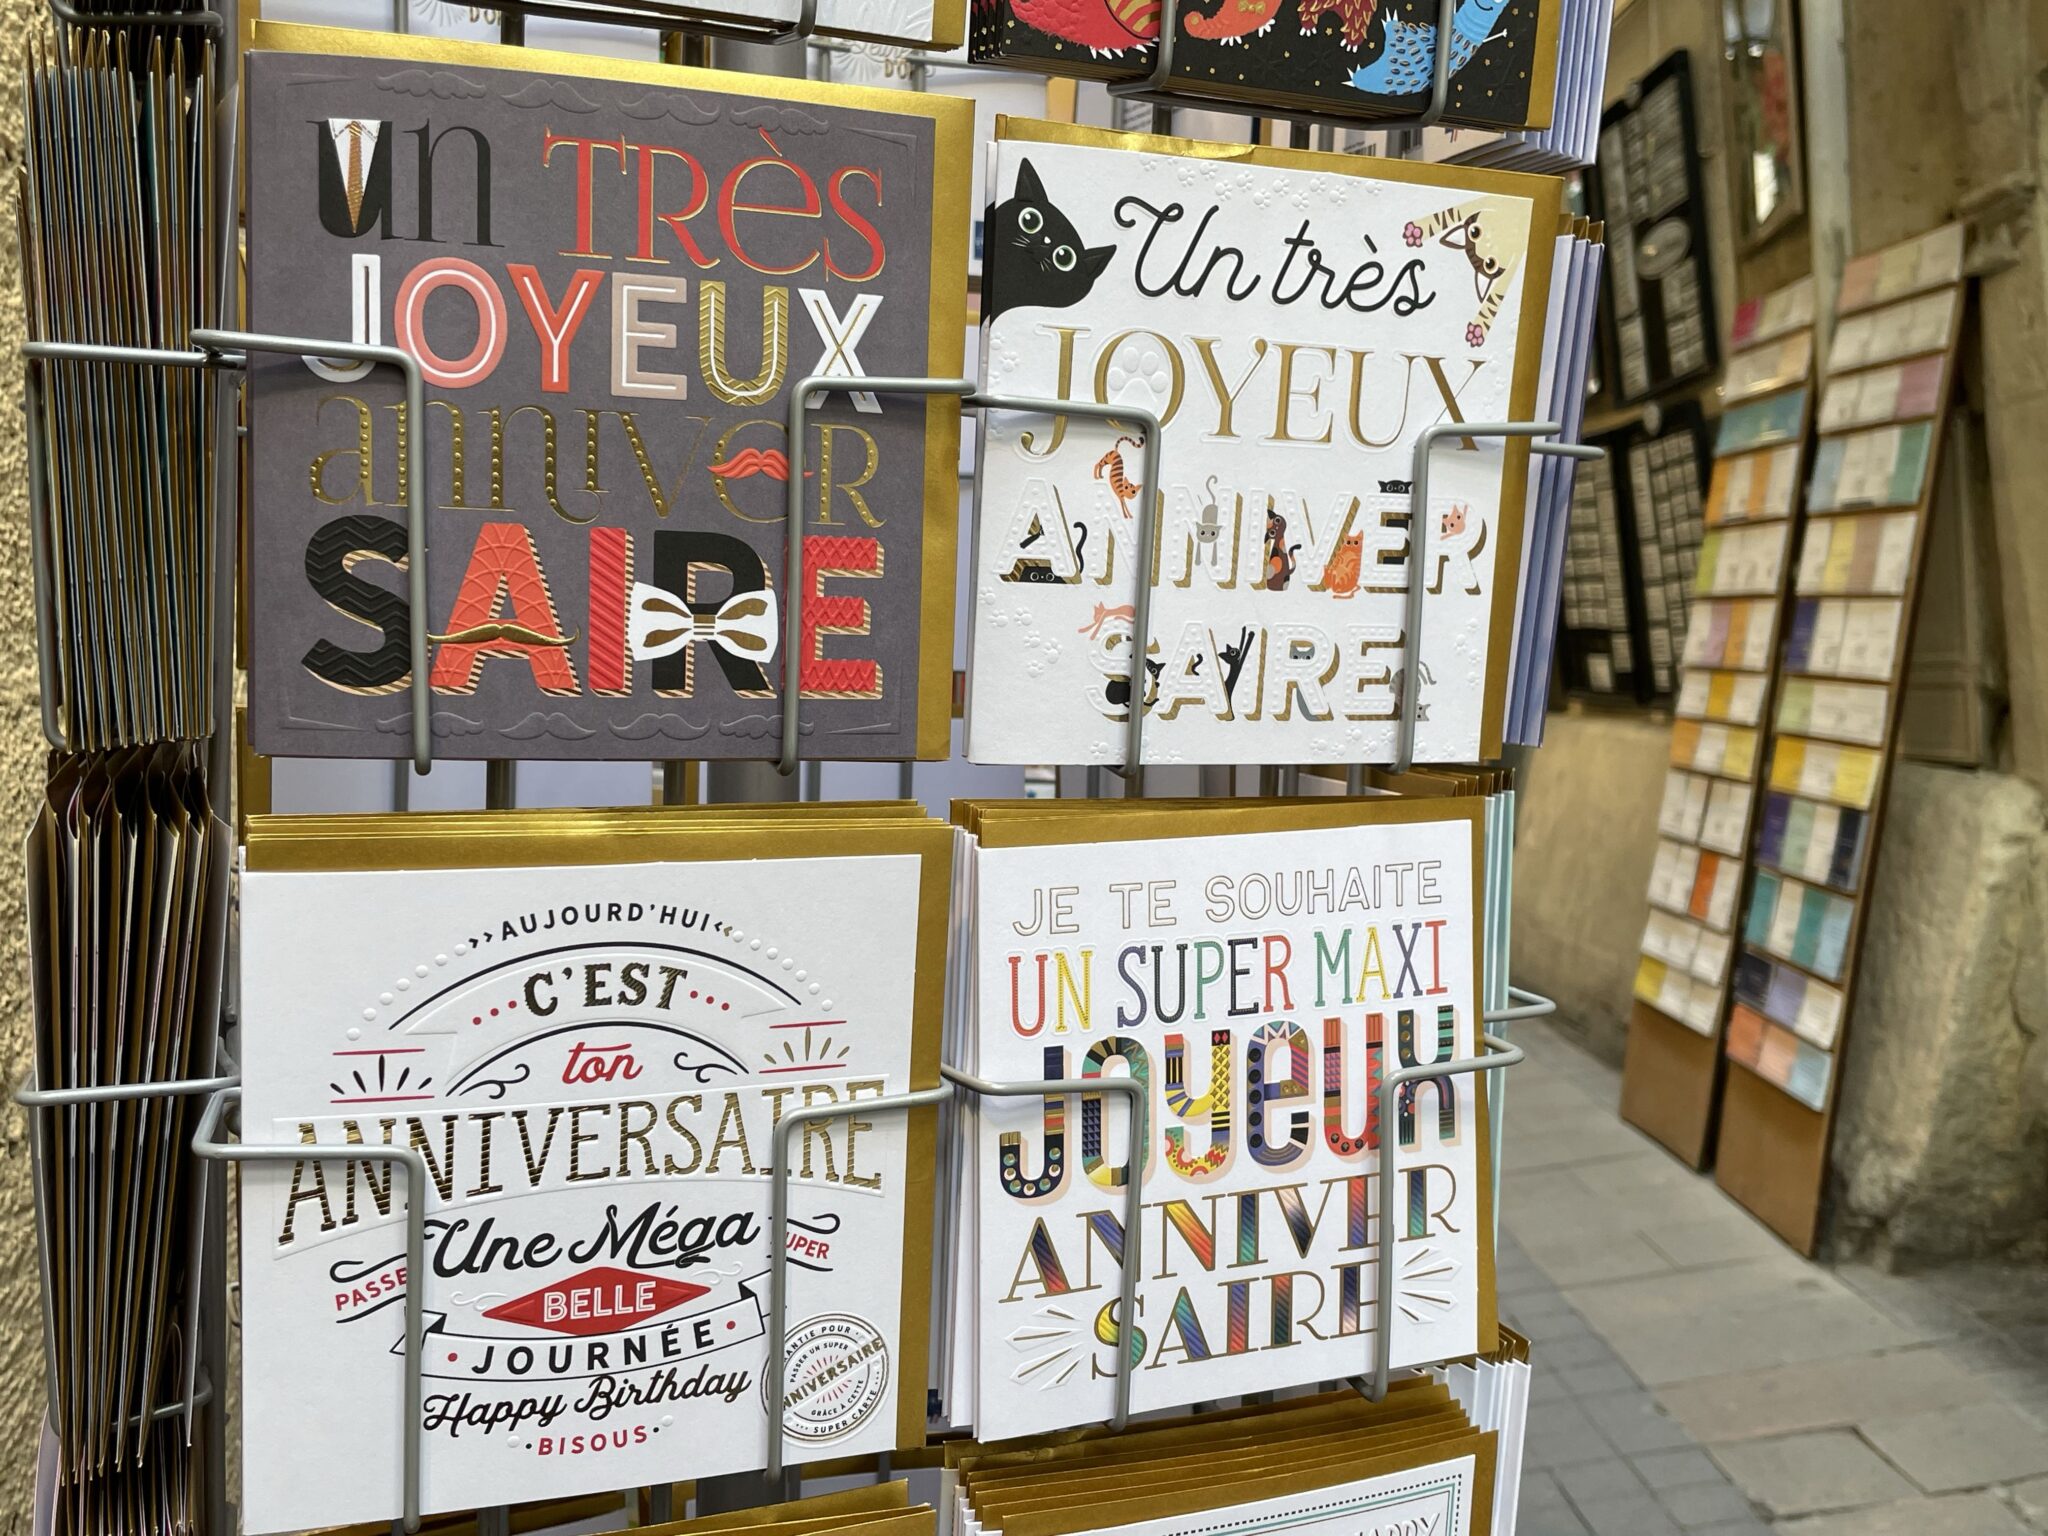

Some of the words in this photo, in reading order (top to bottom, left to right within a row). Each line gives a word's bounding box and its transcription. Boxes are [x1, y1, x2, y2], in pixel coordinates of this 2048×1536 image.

[1114, 195, 1261, 300] Un
[1271, 219, 1437, 317] très
[301, 253, 884, 414] JOYEUX
[1020, 322, 1486, 457] JOYEUX
[992, 477, 1487, 595] ANNIVER
[301, 514, 885, 700] SAIRE
[1085, 618, 1412, 722] SAIRE
[500, 901, 710, 942] AUJOURD'HUI
[1011, 886, 1080, 936] JE
[1108, 880, 1177, 930] TE
[1204, 859, 1443, 924] SOUHAITE
[523, 960, 688, 1018] C'EST
[1007, 949, 1094, 1038] UN
[1116, 934, 1295, 1029] SUPER
[1314, 918, 1449, 1008] MAXI
[561, 1041, 643, 1084] ton
[278, 1078, 886, 1244] ANNIVERSAIRE
[423, 1217, 563, 1278] Une
[567, 1199, 761, 1267] Méga
[784, 1231, 830, 1260] UPER
[997, 1163, 1461, 1304] ANNIVER
[543, 1281, 657, 1324] BELLE
[821, 1324, 851, 1335] POUR
[1091, 1257, 1378, 1380] SAIRE
[472, 1319, 713, 1376] JOURNÉE
[783, 1336, 886, 1412] NNIVERSAIRE
[790, 1354, 808, 1383] PASSER
[809, 1344, 821, 1355] UN
[823, 1342, 849, 1351] SUPER
[423, 1390, 568, 1437] Happy
[574, 1363, 752, 1421] Birthday
[813, 1420, 849, 1434] SUPER
[851, 1390, 877, 1420] CARTE
[847, 1380, 864, 1404] CETTE
[538, 1425, 648, 1456] BISOUS
